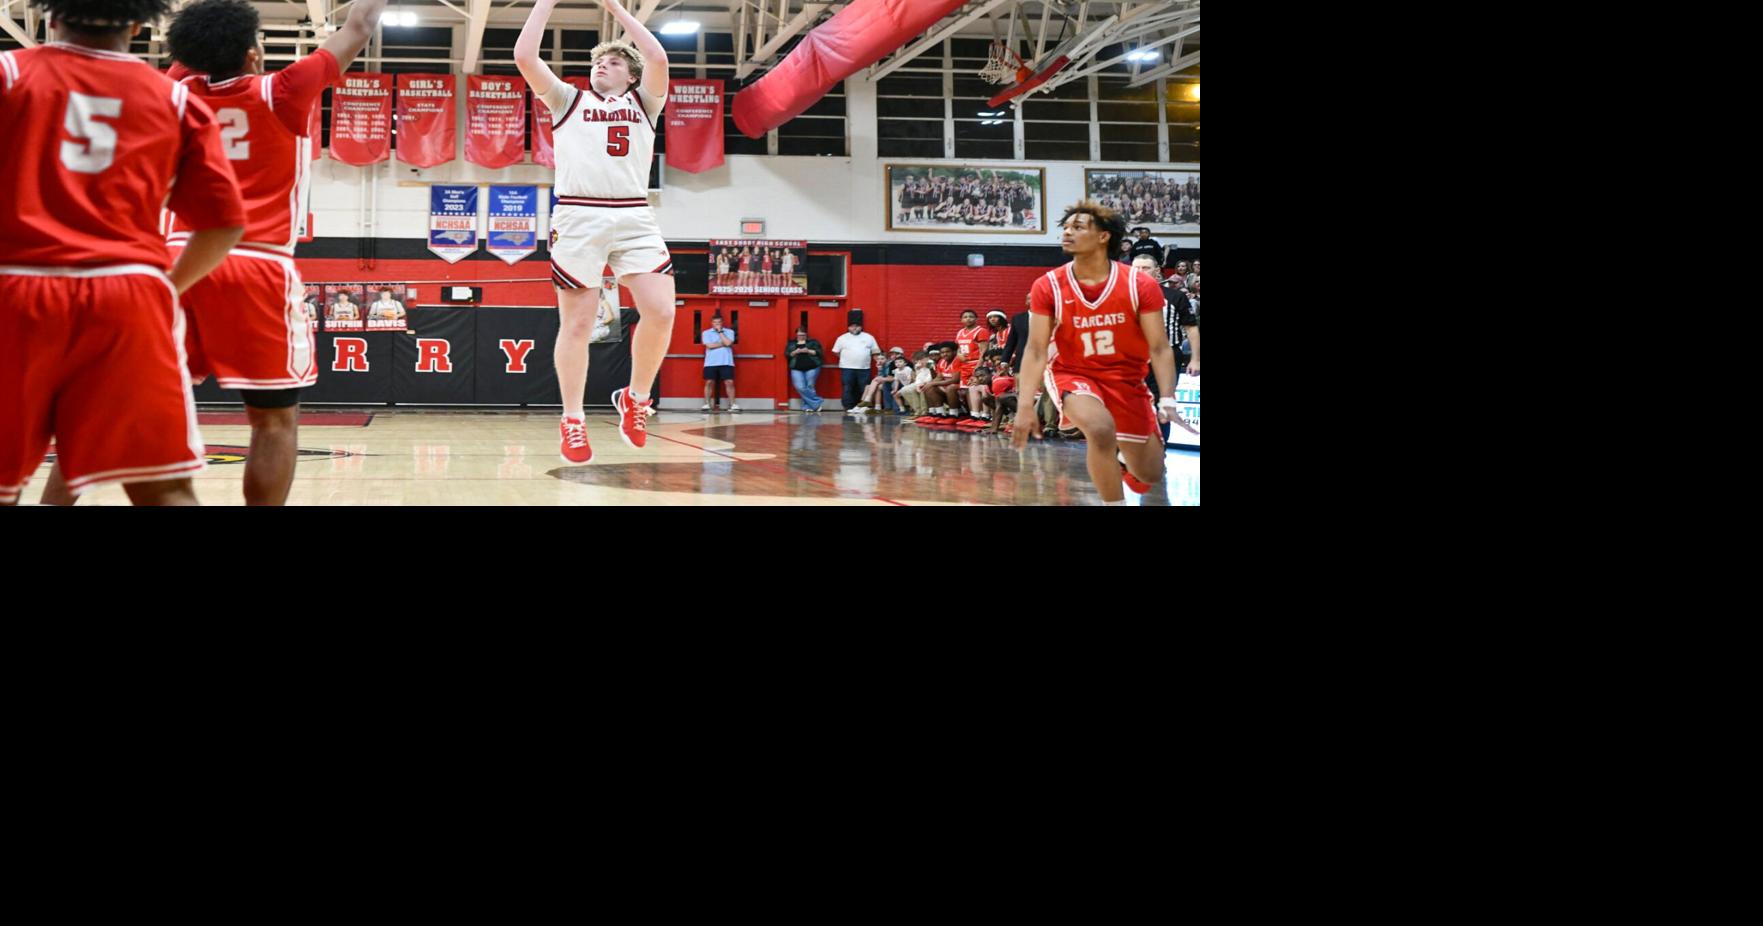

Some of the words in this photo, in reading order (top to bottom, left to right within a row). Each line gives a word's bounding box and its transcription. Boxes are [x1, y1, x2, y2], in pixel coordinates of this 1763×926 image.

[345, 79, 380, 88] GIRL'S
[409, 80, 443, 89] GIRL'S
[481, 82, 511, 91] BOY'S
[336, 87, 389, 96] BASKETBALL
[400, 89, 453, 97] BASKETBALL
[470, 90, 522, 99] BASKETBALL
[673, 86, 715, 94] WOMEN'S
[669, 94, 720, 103] WRESTLING
[60, 90, 123, 174] 5
[606, 125, 630, 156] 5
[436, 220, 471, 230] NCHSAA
[494, 221, 530, 231] NCHSAA
[325, 320, 363, 328] SUTPHIN
[367, 319, 406, 328] DAVIS
[1072, 312, 1126, 329] EARCATS
[1080, 329, 1116, 357] 12
